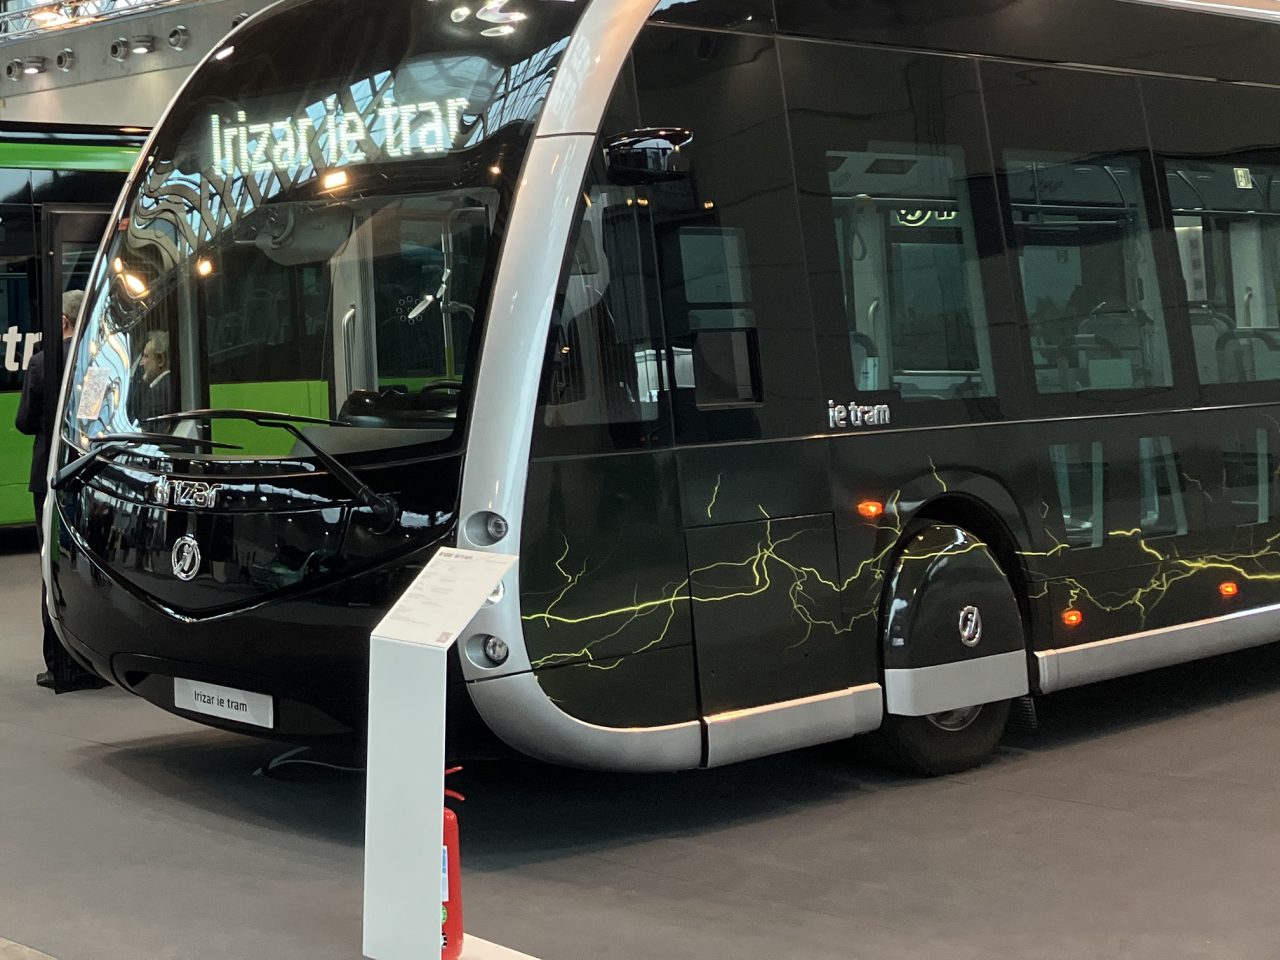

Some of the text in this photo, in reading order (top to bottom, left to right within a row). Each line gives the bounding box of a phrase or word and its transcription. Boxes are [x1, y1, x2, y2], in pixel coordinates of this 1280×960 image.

[828, 399, 891, 428] ie tram
[194, 689, 248, 713] Irizar ie tram
